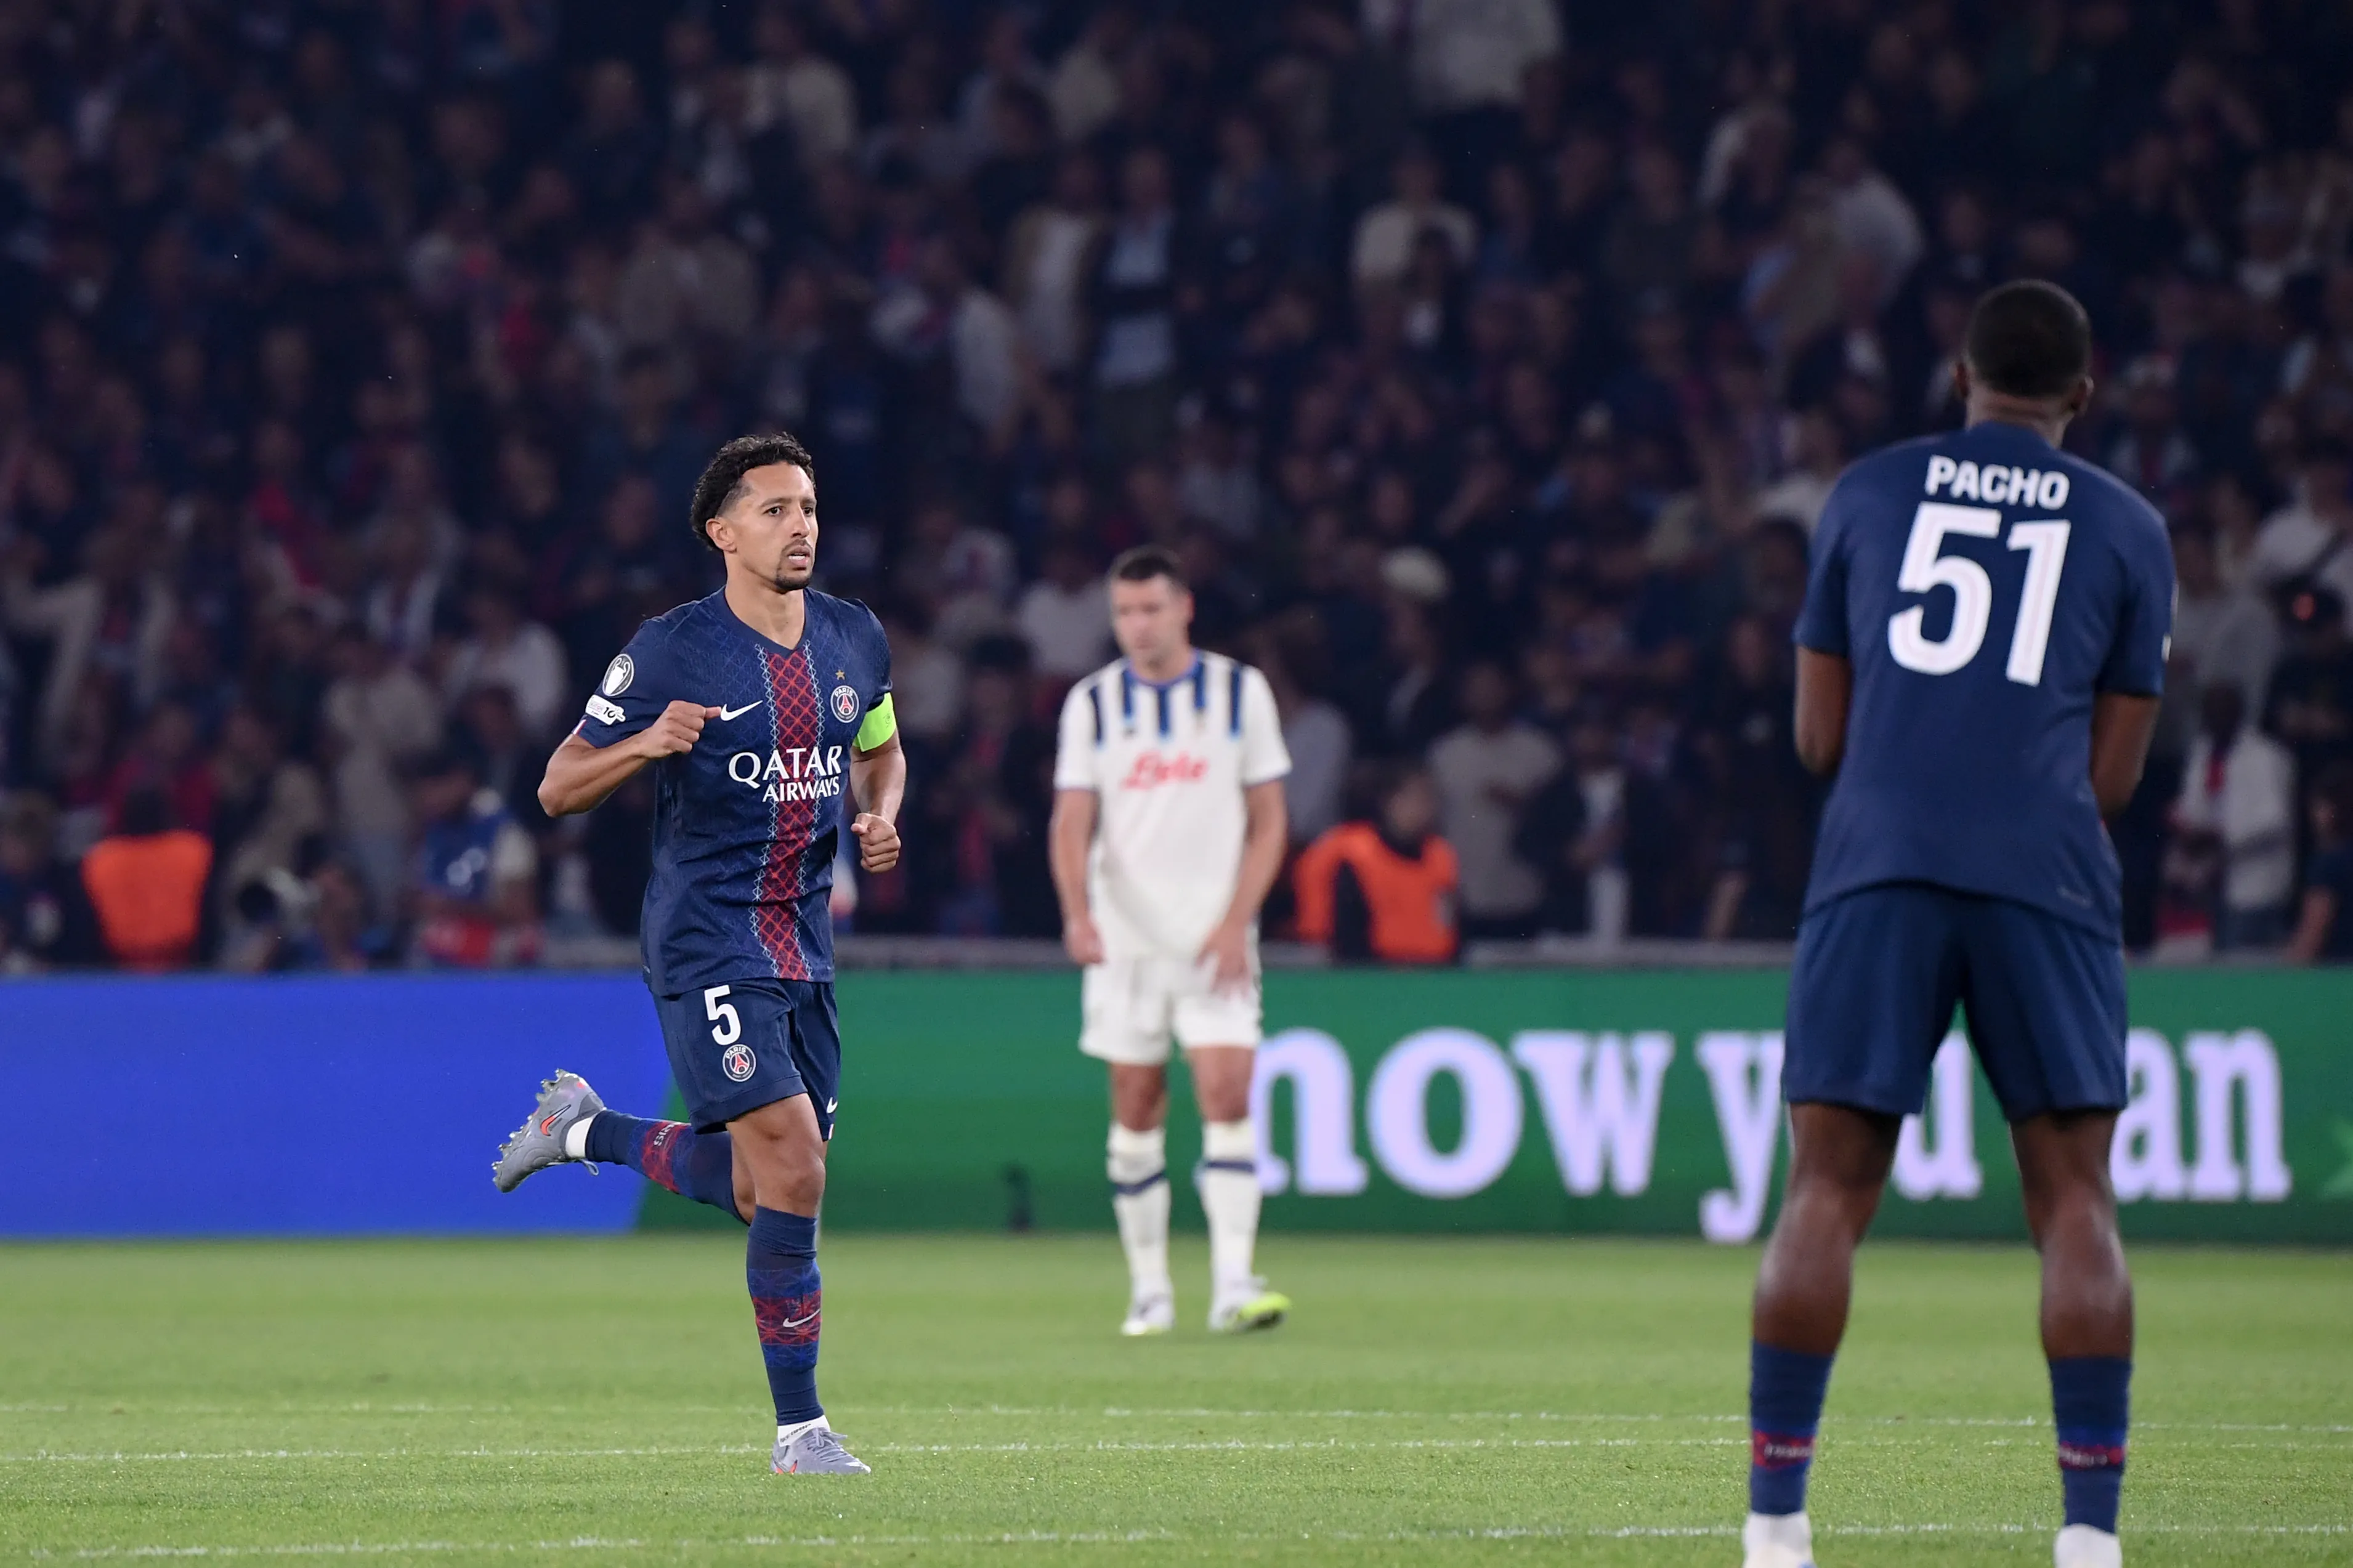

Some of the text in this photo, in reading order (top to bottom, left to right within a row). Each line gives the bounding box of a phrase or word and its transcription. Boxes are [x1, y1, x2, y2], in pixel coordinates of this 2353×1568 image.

[1925, 455, 2070, 511] PACHO
[1887, 501, 2072, 687] 51
[835, 687, 853, 697] PARIS
[728, 745, 843, 789] QATAR
[762, 776, 840, 802] AIRWAYS
[704, 985, 741, 1046] 5
[726, 1046, 747, 1059] PARIS
[1193, 1025, 2293, 1243] now yu an
